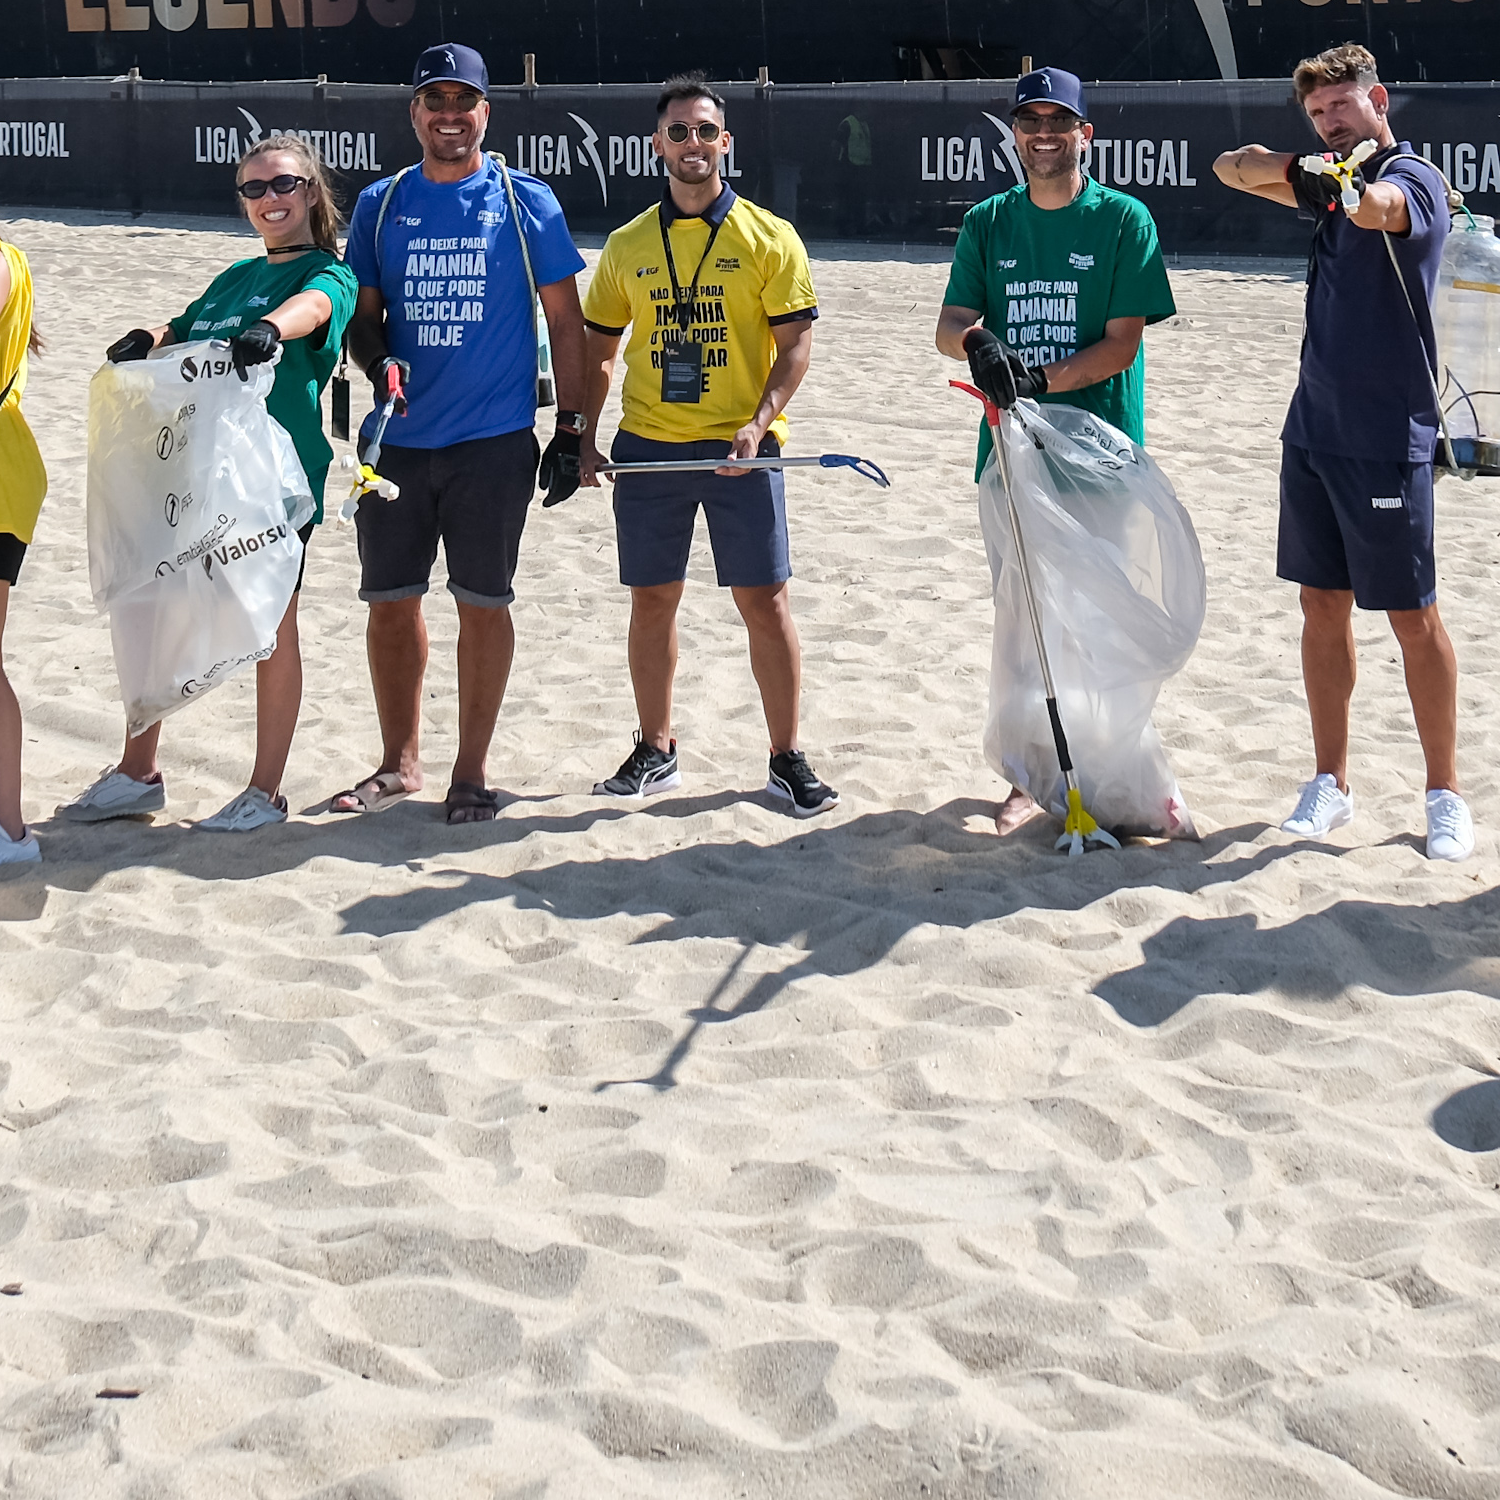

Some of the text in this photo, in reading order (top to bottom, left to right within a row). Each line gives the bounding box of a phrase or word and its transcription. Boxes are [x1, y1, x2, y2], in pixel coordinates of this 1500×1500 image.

[195, 126, 241, 164] LIGA
[516, 134, 572, 176] LIGA
[921, 137, 986, 182] LIGA
[406, 217, 422, 227] EGF
[407, 237, 488, 250] NÃO DEIXE PARA
[405, 250, 487, 277] AMANHÃ
[646, 266, 659, 275] EGF
[404, 279, 486, 300] O QUE PODE
[650, 286, 669, 301] NÃO
[700, 285, 724, 297] PARA
[1005, 280, 1078, 296] NÃO DEIXE PARA
[403, 301, 484, 322] RECICLAR
[1006, 295, 1077, 324] AMANHÃ
[417, 325, 464, 347] HOJE
[693, 326, 728, 343] PODE
[1007, 323, 1077, 346] O QUE PODE
[1371, 497, 1403, 510] PUMA
[214, 524, 287, 566] Valorsu
